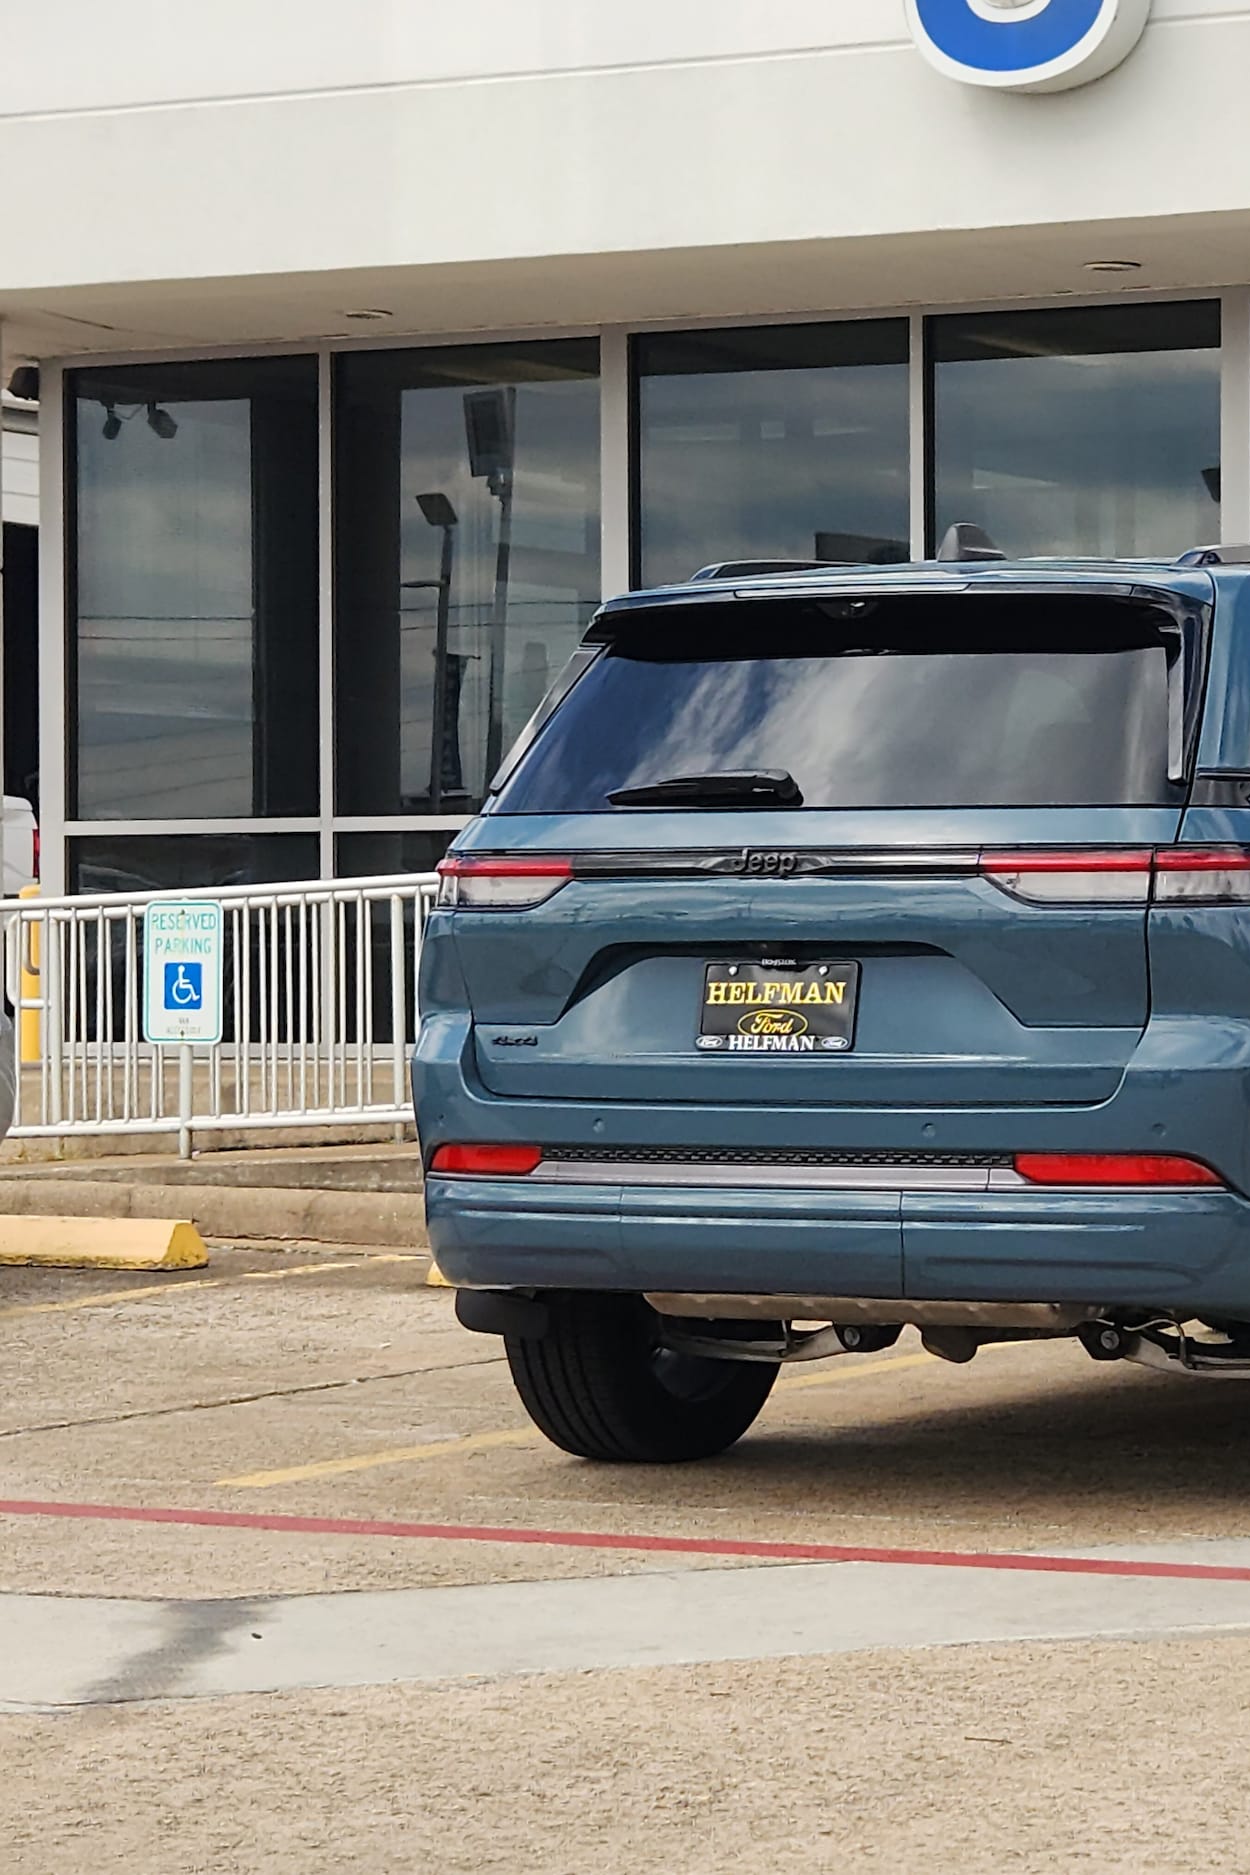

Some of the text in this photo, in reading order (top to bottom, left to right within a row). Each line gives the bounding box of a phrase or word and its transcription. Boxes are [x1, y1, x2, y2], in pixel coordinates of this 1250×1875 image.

[732, 847, 797, 877] Jeep
[152, 912, 216, 931] RESERVED
[154, 937, 211, 955] PARKING
[705, 981, 847, 1005] HELFMAN
[750, 1011, 794, 1034] Ford
[727, 1034, 816, 1051] HELFMAN
